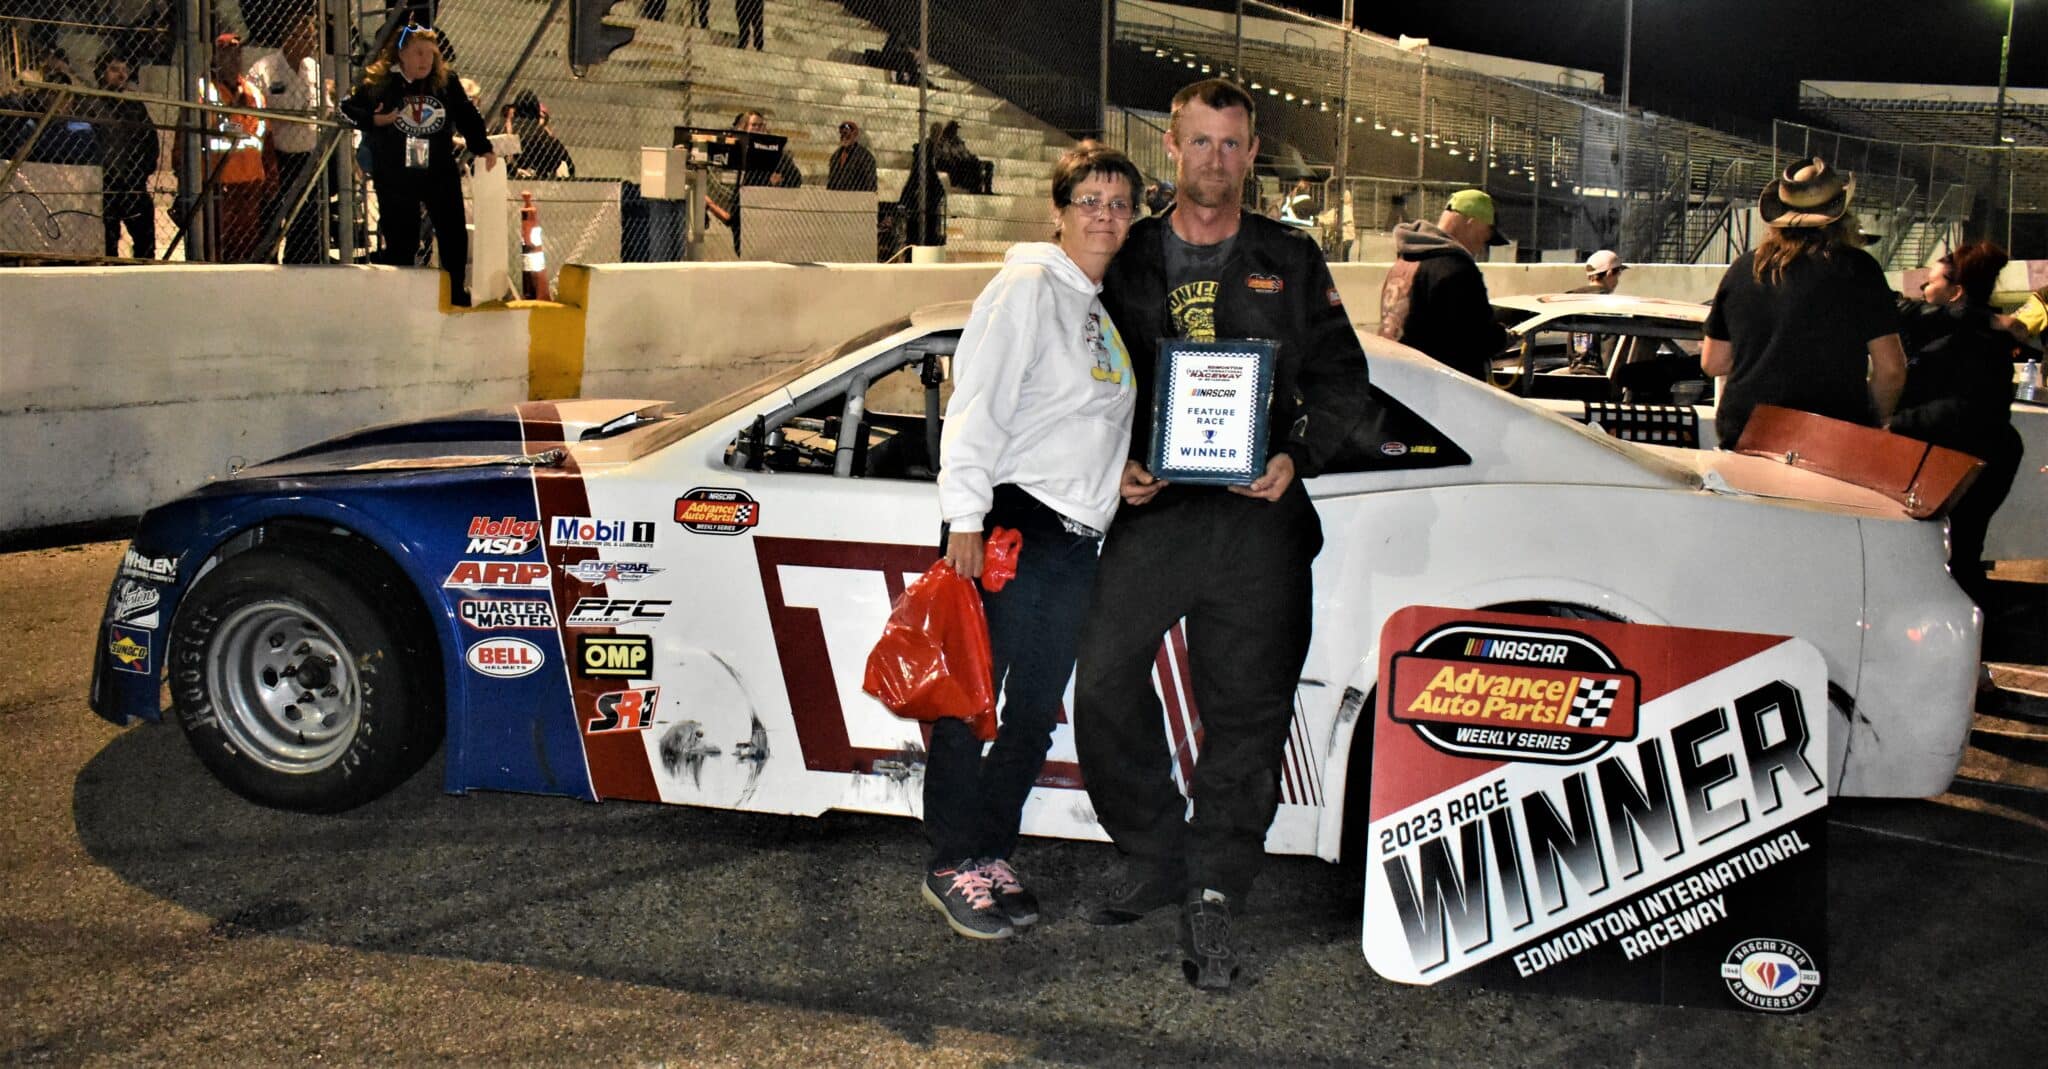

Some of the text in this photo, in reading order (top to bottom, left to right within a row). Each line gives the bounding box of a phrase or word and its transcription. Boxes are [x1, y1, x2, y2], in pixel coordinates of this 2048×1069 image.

[1200, 388, 1237, 397] NASCAR
[1188, 407, 1236, 416] FEATURE
[1196, 417, 1225, 425] RACE
[1180, 447, 1237, 458] WINNER
[681, 511, 731, 522] Auto Parts
[688, 502, 735, 514] Advance
[468, 516, 540, 542] Holley
[557, 518, 625, 542] Mobil
[466, 538, 528, 555] MSD
[125, 549, 177, 576] WHELEN
[449, 562, 550, 585] ARP
[580, 562, 648, 573] FIVE STAR
[462, 602, 547, 619] QUARTER
[572, 599, 672, 617] PFC
[478, 614, 551, 627] MASTER
[111, 642, 148, 658] SUNOCO
[478, 647, 533, 665] BELL
[585, 645, 647, 668] OMP
[1489, 639, 1568, 664] NASCAR
[1426, 666, 1566, 701] Advance
[1408, 691, 1558, 724] Auto Parts
[1456, 727, 1572, 751] WEEKLY SERIES
[1379, 778, 1511, 855] 2023 RACE
[1382, 680, 1825, 974] WINNER
[1512, 830, 1810, 979] EDMONTON INTERNATIONAL
[1620, 894, 1729, 961] RACEWAY
[1734, 941, 1807, 965] NASCAR 75TH
[1732, 981, 1809, 1008] ANNIVERSARY
